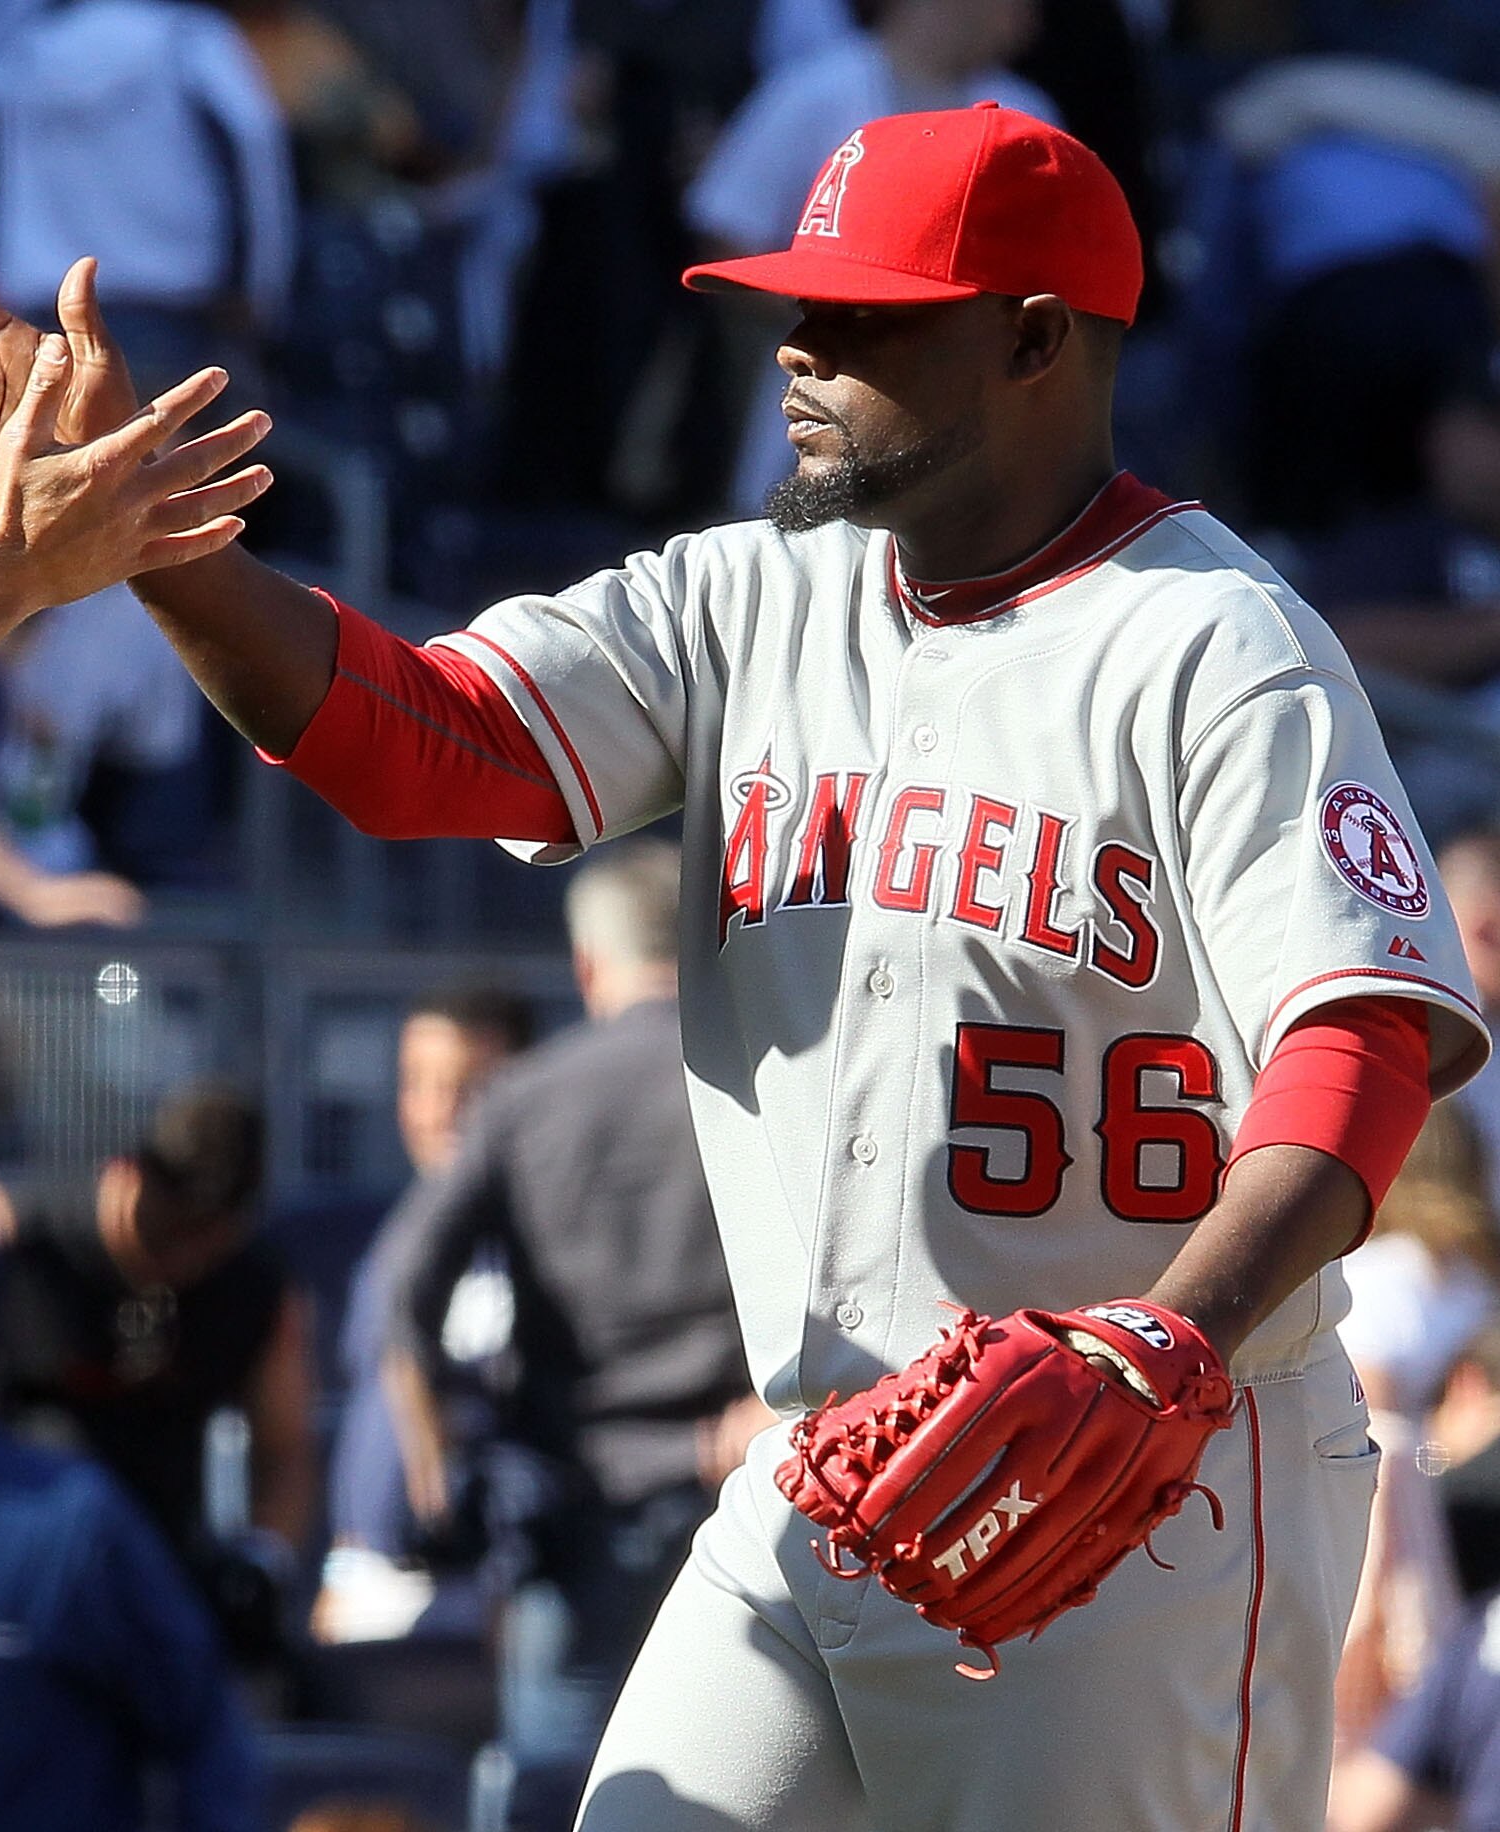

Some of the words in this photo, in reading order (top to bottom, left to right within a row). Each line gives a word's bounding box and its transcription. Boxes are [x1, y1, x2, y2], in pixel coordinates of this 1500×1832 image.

[797, 129, 865, 238] A
[717, 744, 1162, 992] ANGELS
[948, 1022, 1226, 1224] 56
[931, 1479, 1039, 1580] TPX
